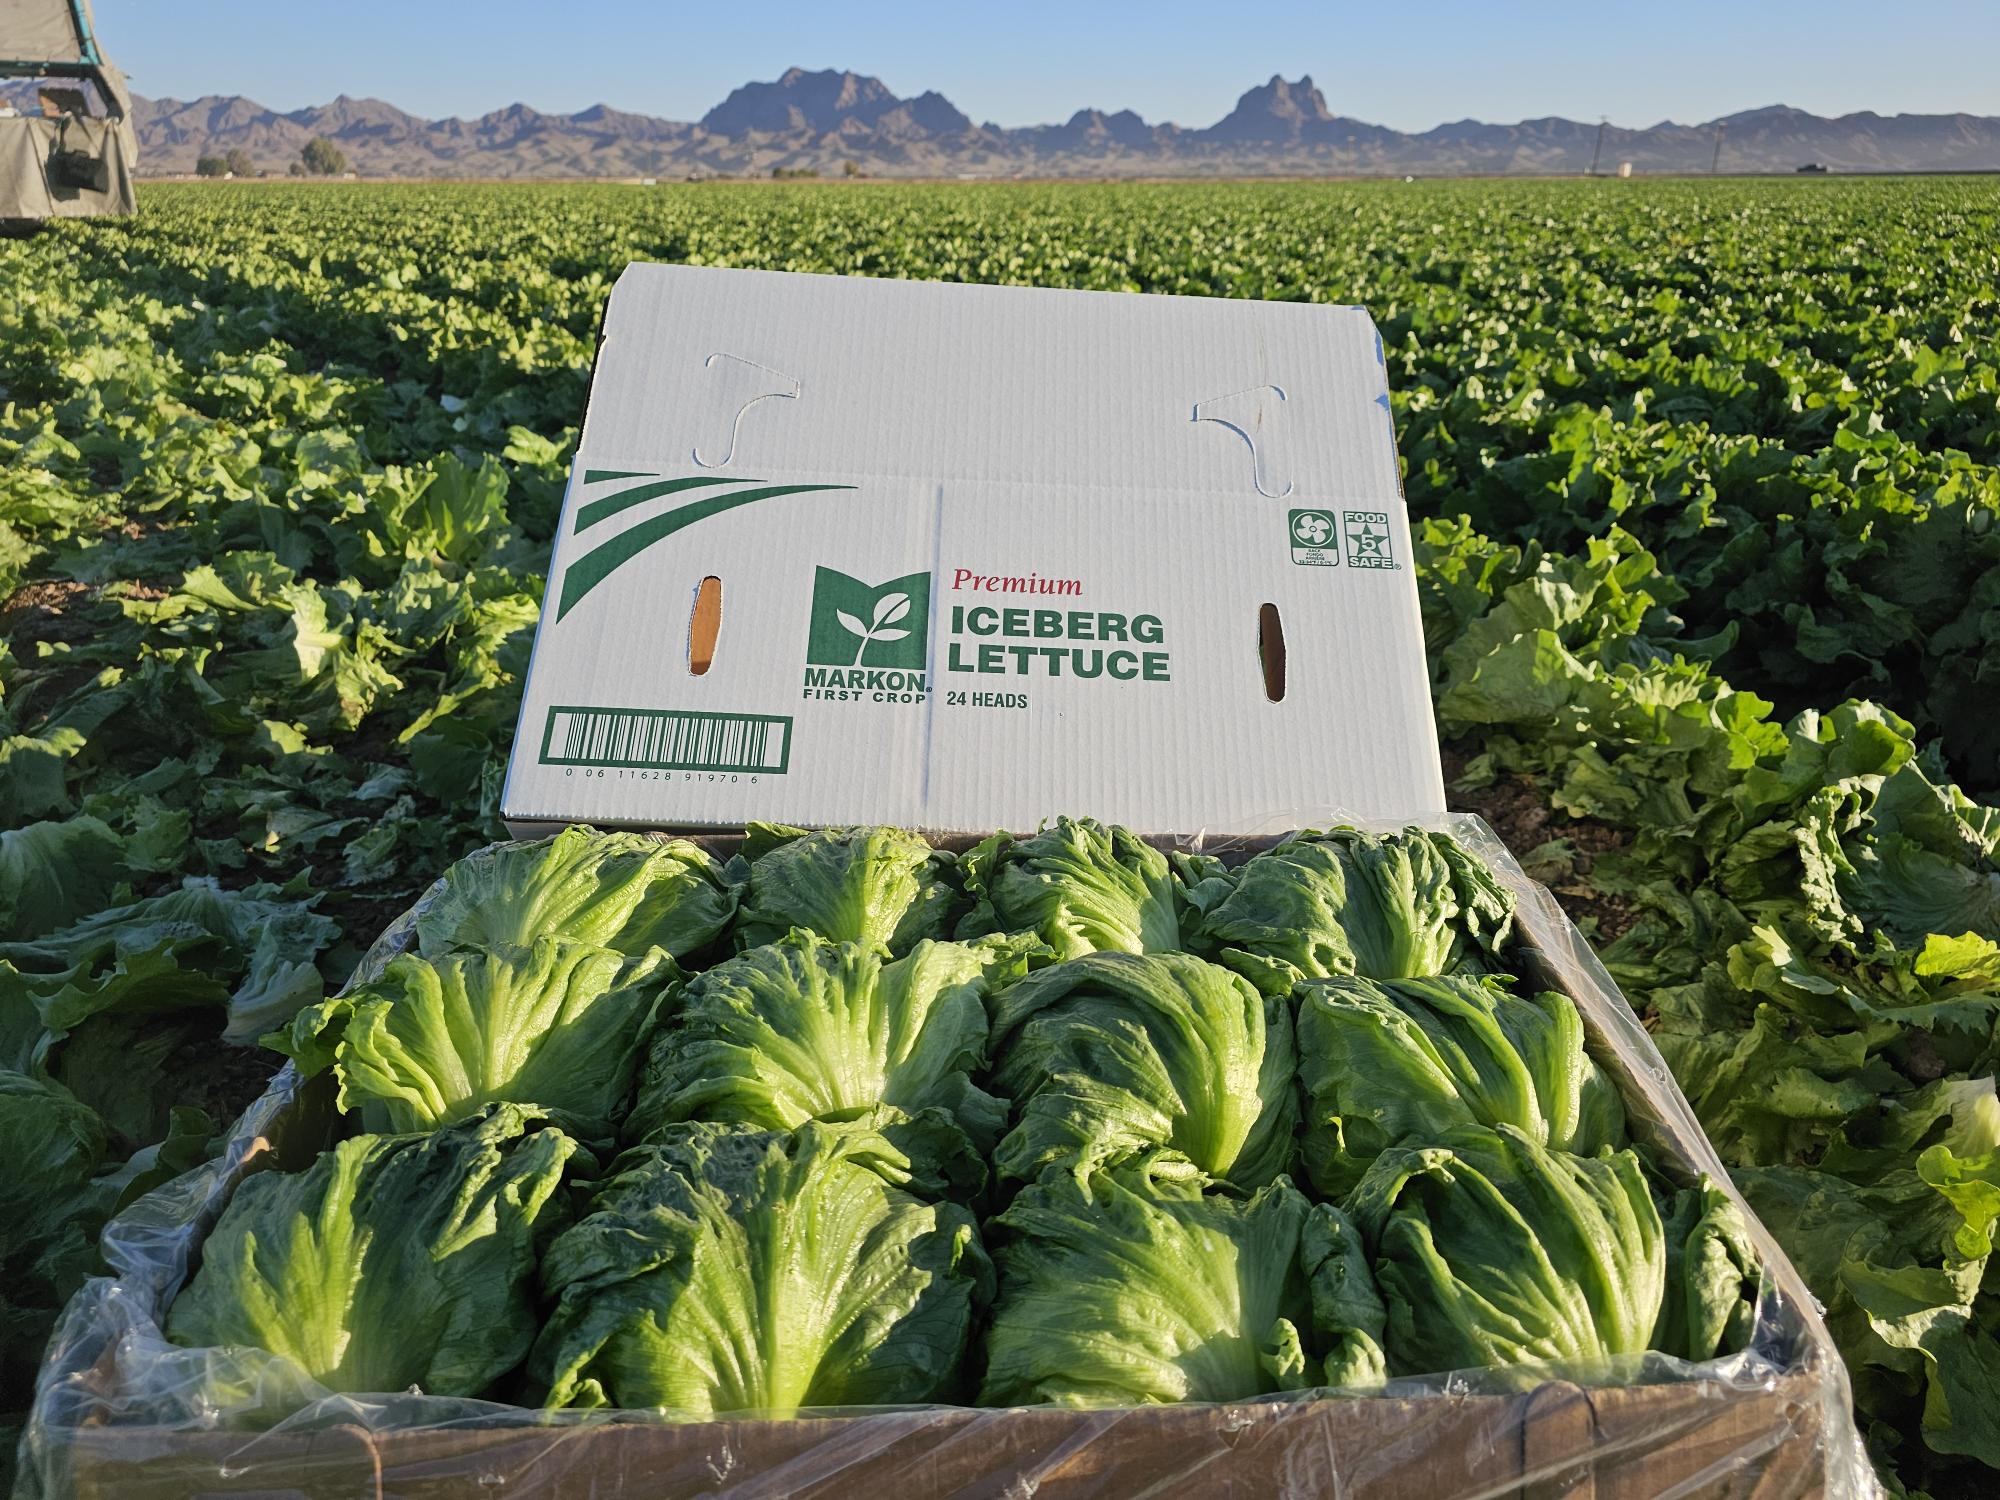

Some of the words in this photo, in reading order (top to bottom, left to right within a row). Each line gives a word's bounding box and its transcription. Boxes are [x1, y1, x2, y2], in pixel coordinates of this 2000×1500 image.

[1344, 512, 1387, 523] FOOD
[1361, 534, 1377, 550] 5
[1349, 557, 1393, 569] SAFE
[951, 568, 1083, 596] Premium
[951, 606, 1164, 644] ICEBERG
[948, 643, 1171, 682] LETTUCE
[803, 689, 863, 702] FIRST
[872, 692, 926, 704] CROP
[946, 691, 967, 706] 24
[972, 692, 1028, 709] HEADS
[586, 768, 605, 778] 06
[618, 770, 671, 781] 11628
[684, 773, 738, 784] 91970
